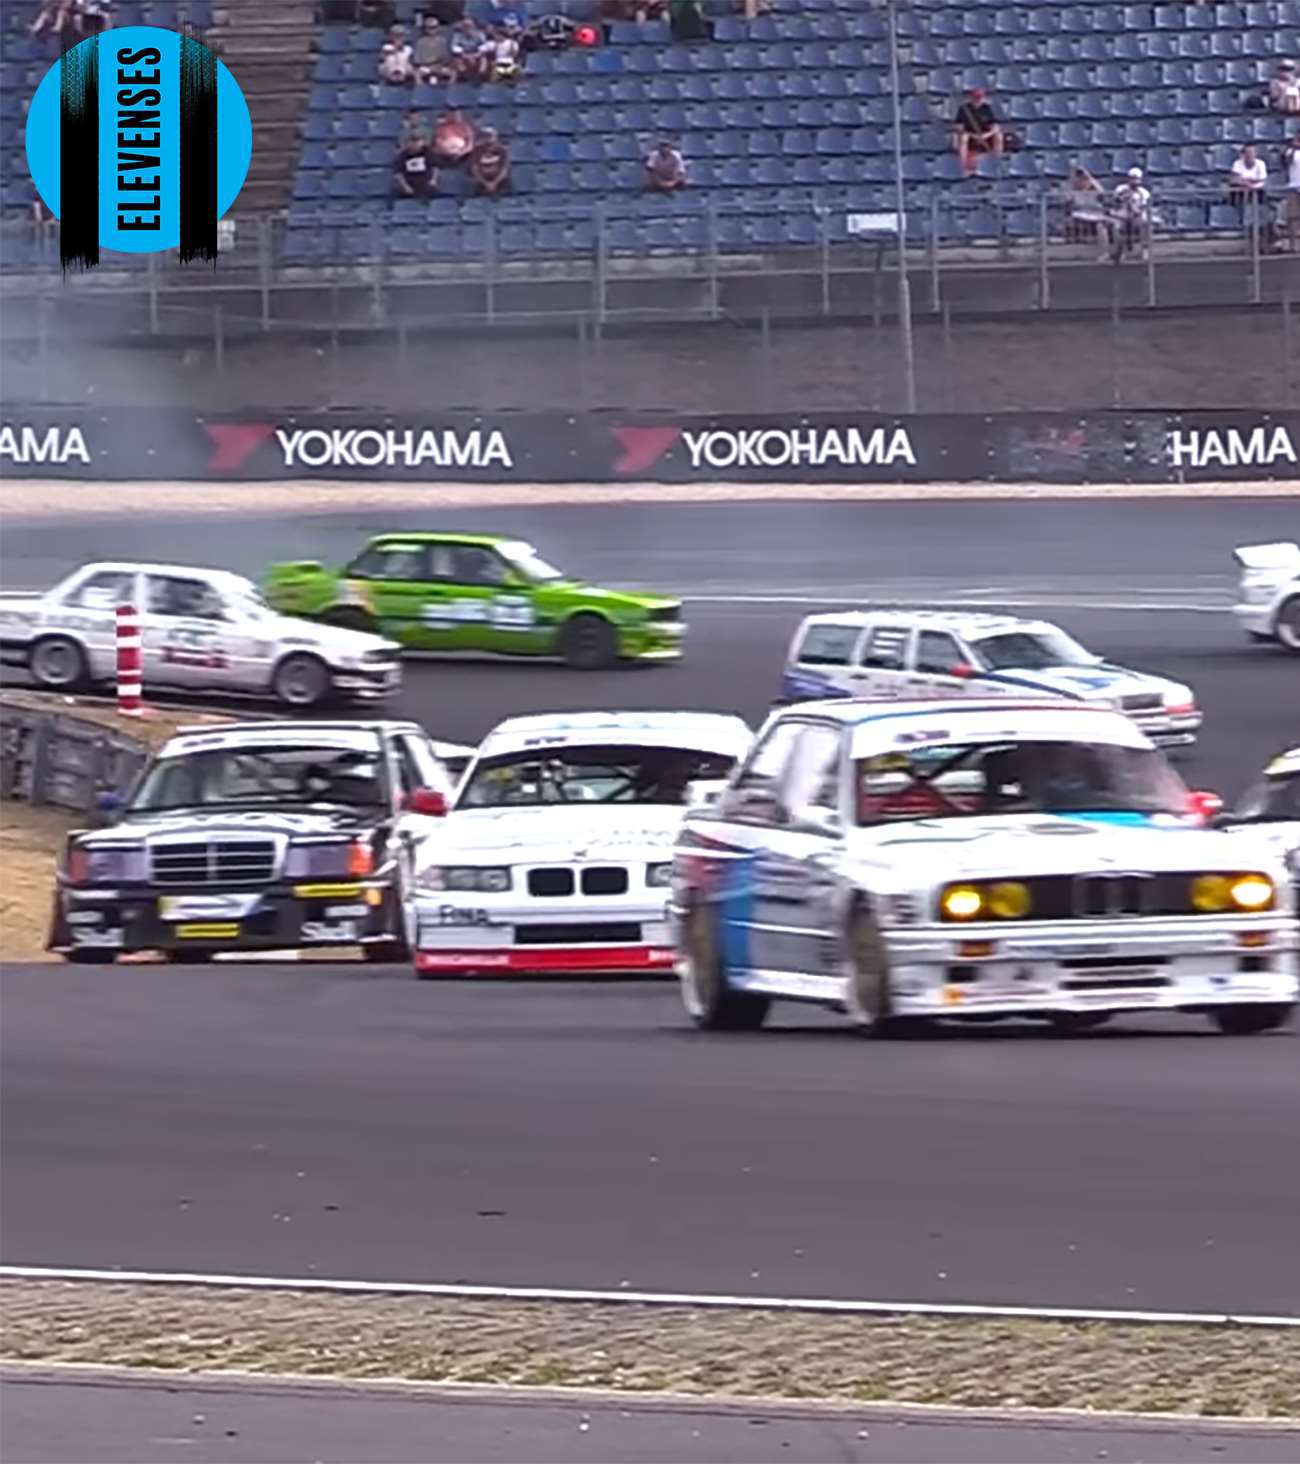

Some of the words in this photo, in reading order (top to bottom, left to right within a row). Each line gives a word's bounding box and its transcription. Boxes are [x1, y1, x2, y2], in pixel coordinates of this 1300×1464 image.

[276, 429, 513, 467] YOKOHAMA
[682, 429, 917, 467] YOKOHAMA
[1172, 427, 1297, 466] HAMA
